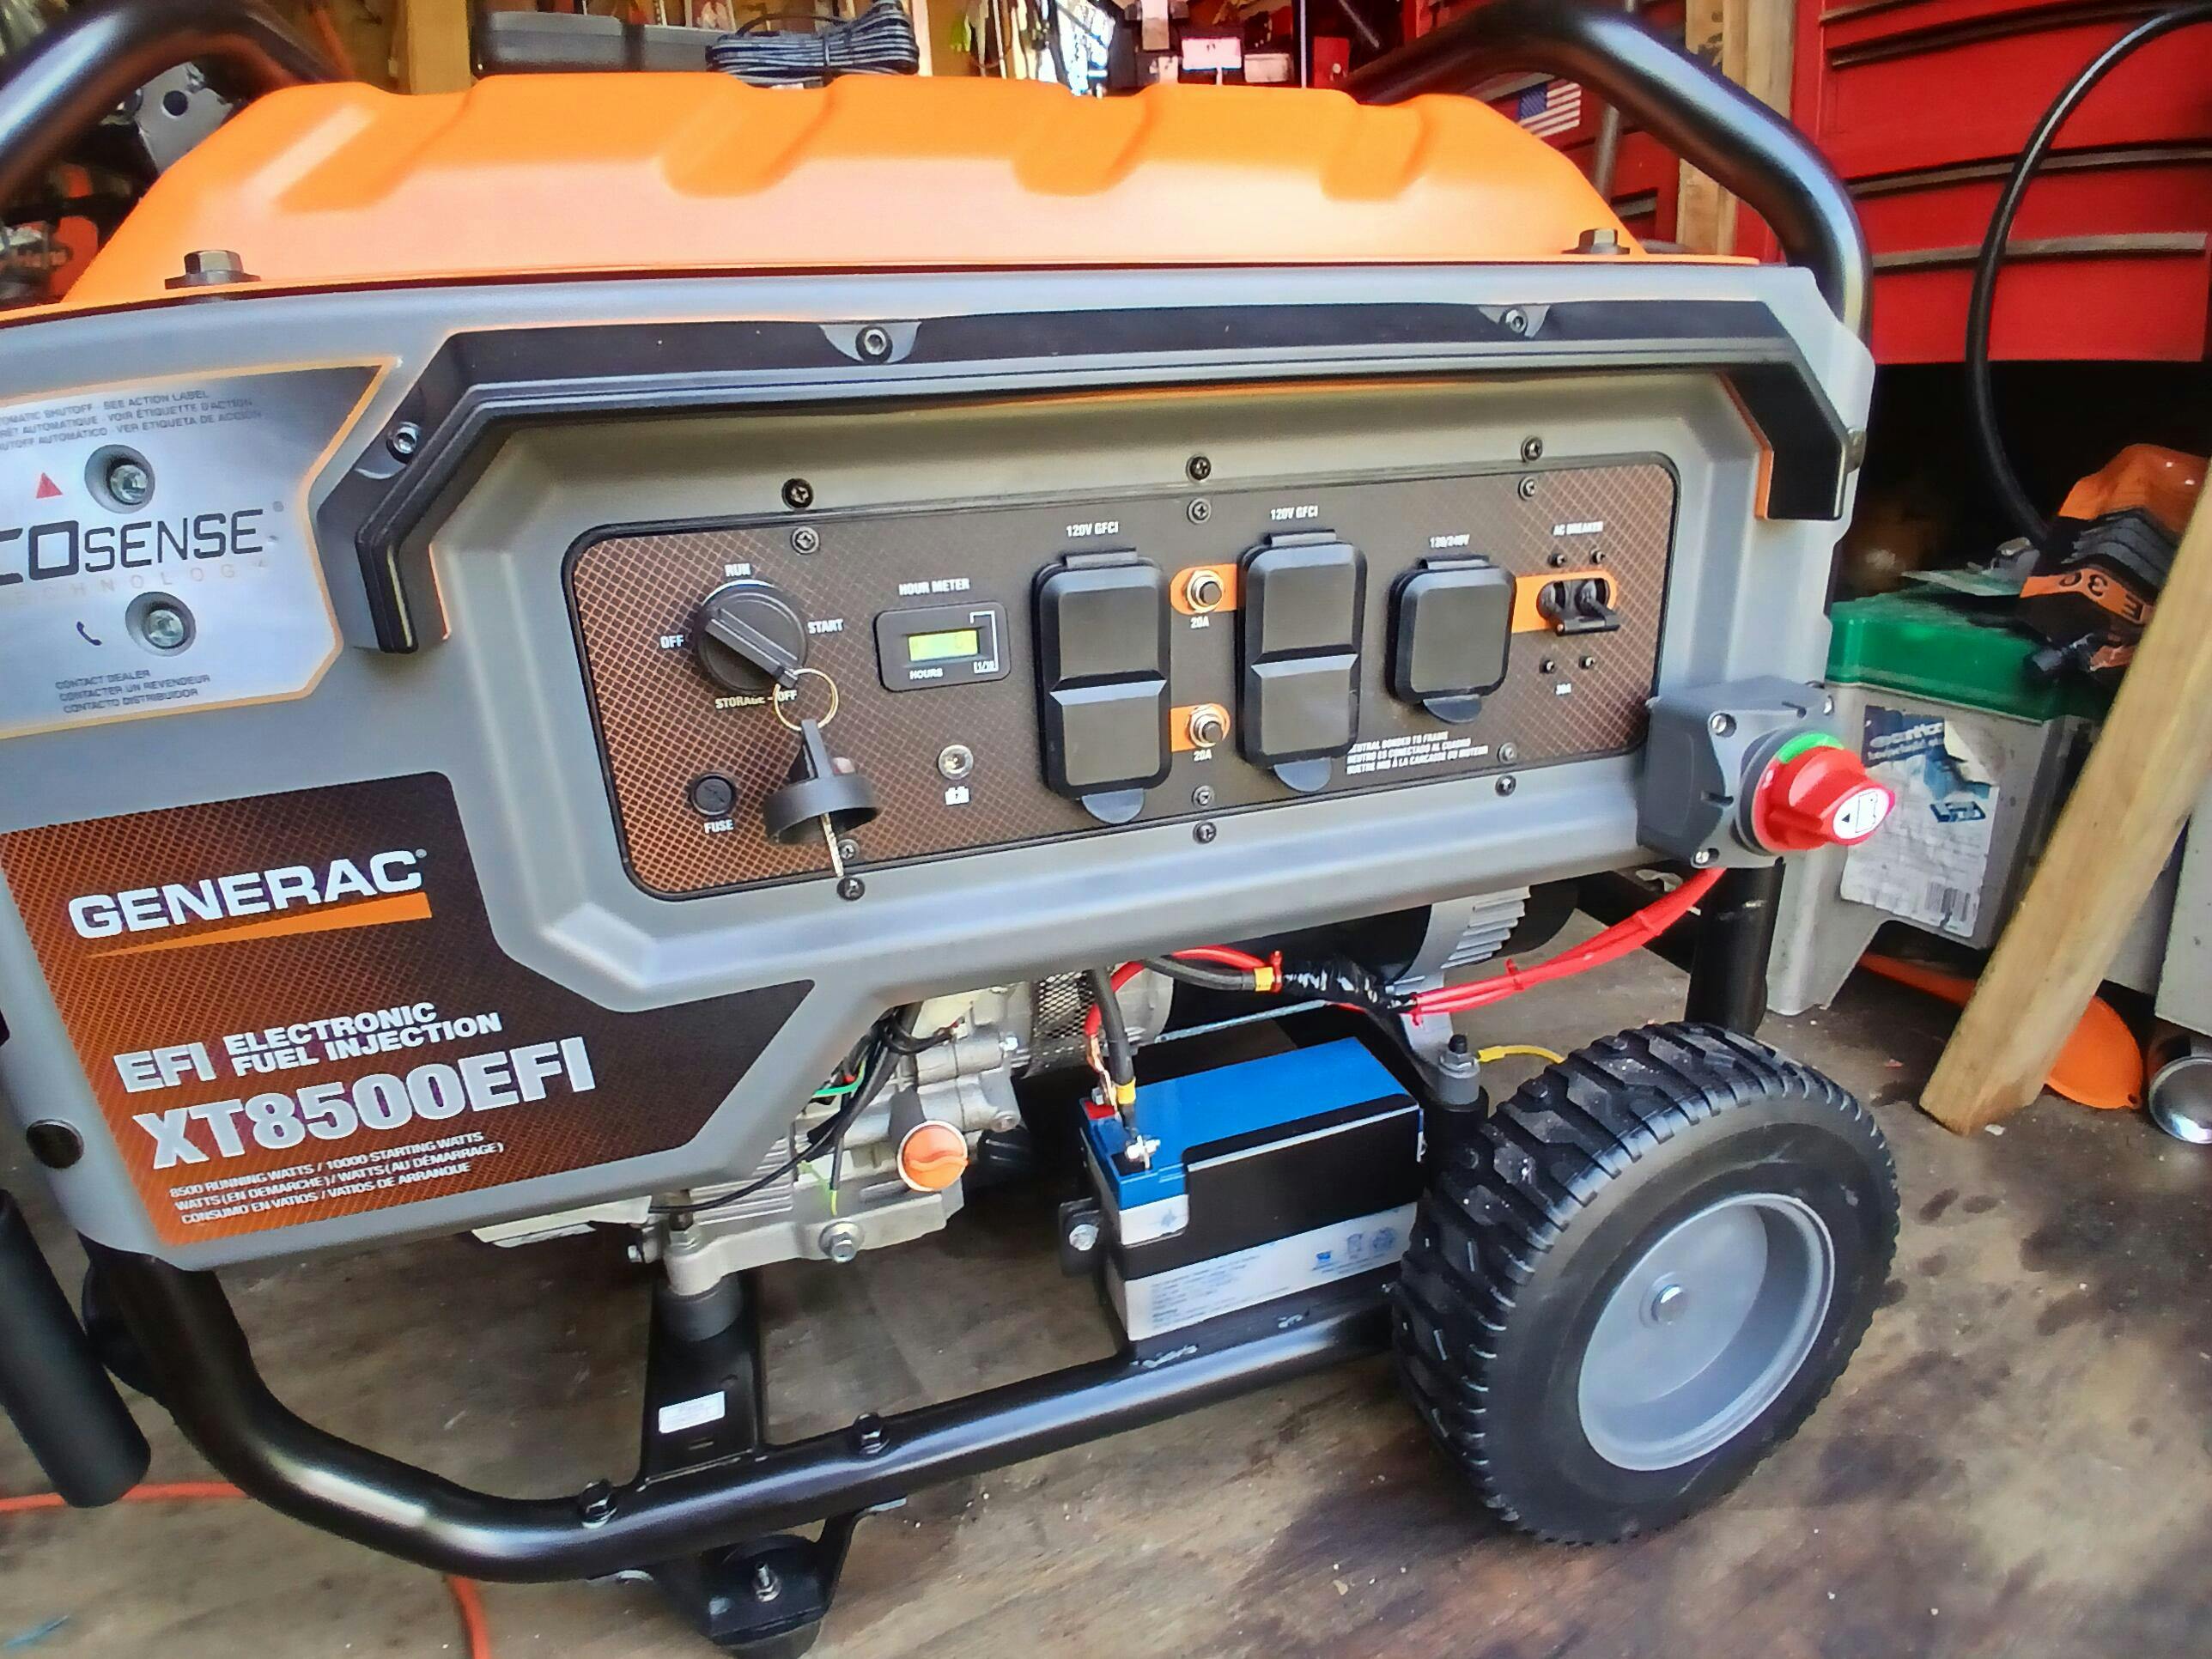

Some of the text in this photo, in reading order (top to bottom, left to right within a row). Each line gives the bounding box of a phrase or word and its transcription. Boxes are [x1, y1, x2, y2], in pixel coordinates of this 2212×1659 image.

[129, 394, 169, 406] ACTION
[172, 390, 210, 401] LABEL
[116, 423, 139, 434] VER
[200, 415, 215, 424] DE
[1269, 505, 1319, 521] 120V GFCI
[1066, 521, 1120, 538] 120V GFCI
[1553, 523, 1565, 536] AC
[724, 562, 751, 577] RUN
[898, 578, 970, 596] HOUR METER
[807, 618, 844, 634] START
[1189, 616, 1210, 629] 20A
[659, 634, 684, 648] OFF
[55, 669, 151, 690] CONTACT DEALER
[909, 668, 943, 680] HOURS
[59, 674, 211, 702] CONTACTER UN REVENDEUR
[776, 690, 798, 702] OFF
[64, 688, 198, 714] CONTACTO DISTRIBUIDOR
[703, 819, 735, 834] FUSE
[69, 850, 422, 939] GENERAC
[222, 1001, 437, 1056] ELECTRONIC
[231, 1012, 503, 1078] FUEL INJECTION
[113, 1042, 216, 1094] EFI
[133, 1036, 596, 1170] XT8500EFI
[170, 1183, 204, 1198] 8500
[205, 1173, 268, 1192] RUNNING
[269, 1164, 315, 1181] WATTS
[327, 1154, 369, 1170] 10000
[370, 1141, 437, 1161] STARTING
[437, 1131, 484, 1148] WATTS
[181, 1204, 249, 1224] CONSUMO
[251, 1200, 271, 1212] EN
[271, 1191, 319, 1208] VATIOS
[327, 1180, 376, 1198] VATIOS
[377, 1176, 398, 1188] DE
[398, 1162, 472, 1184] ARRANQUE
